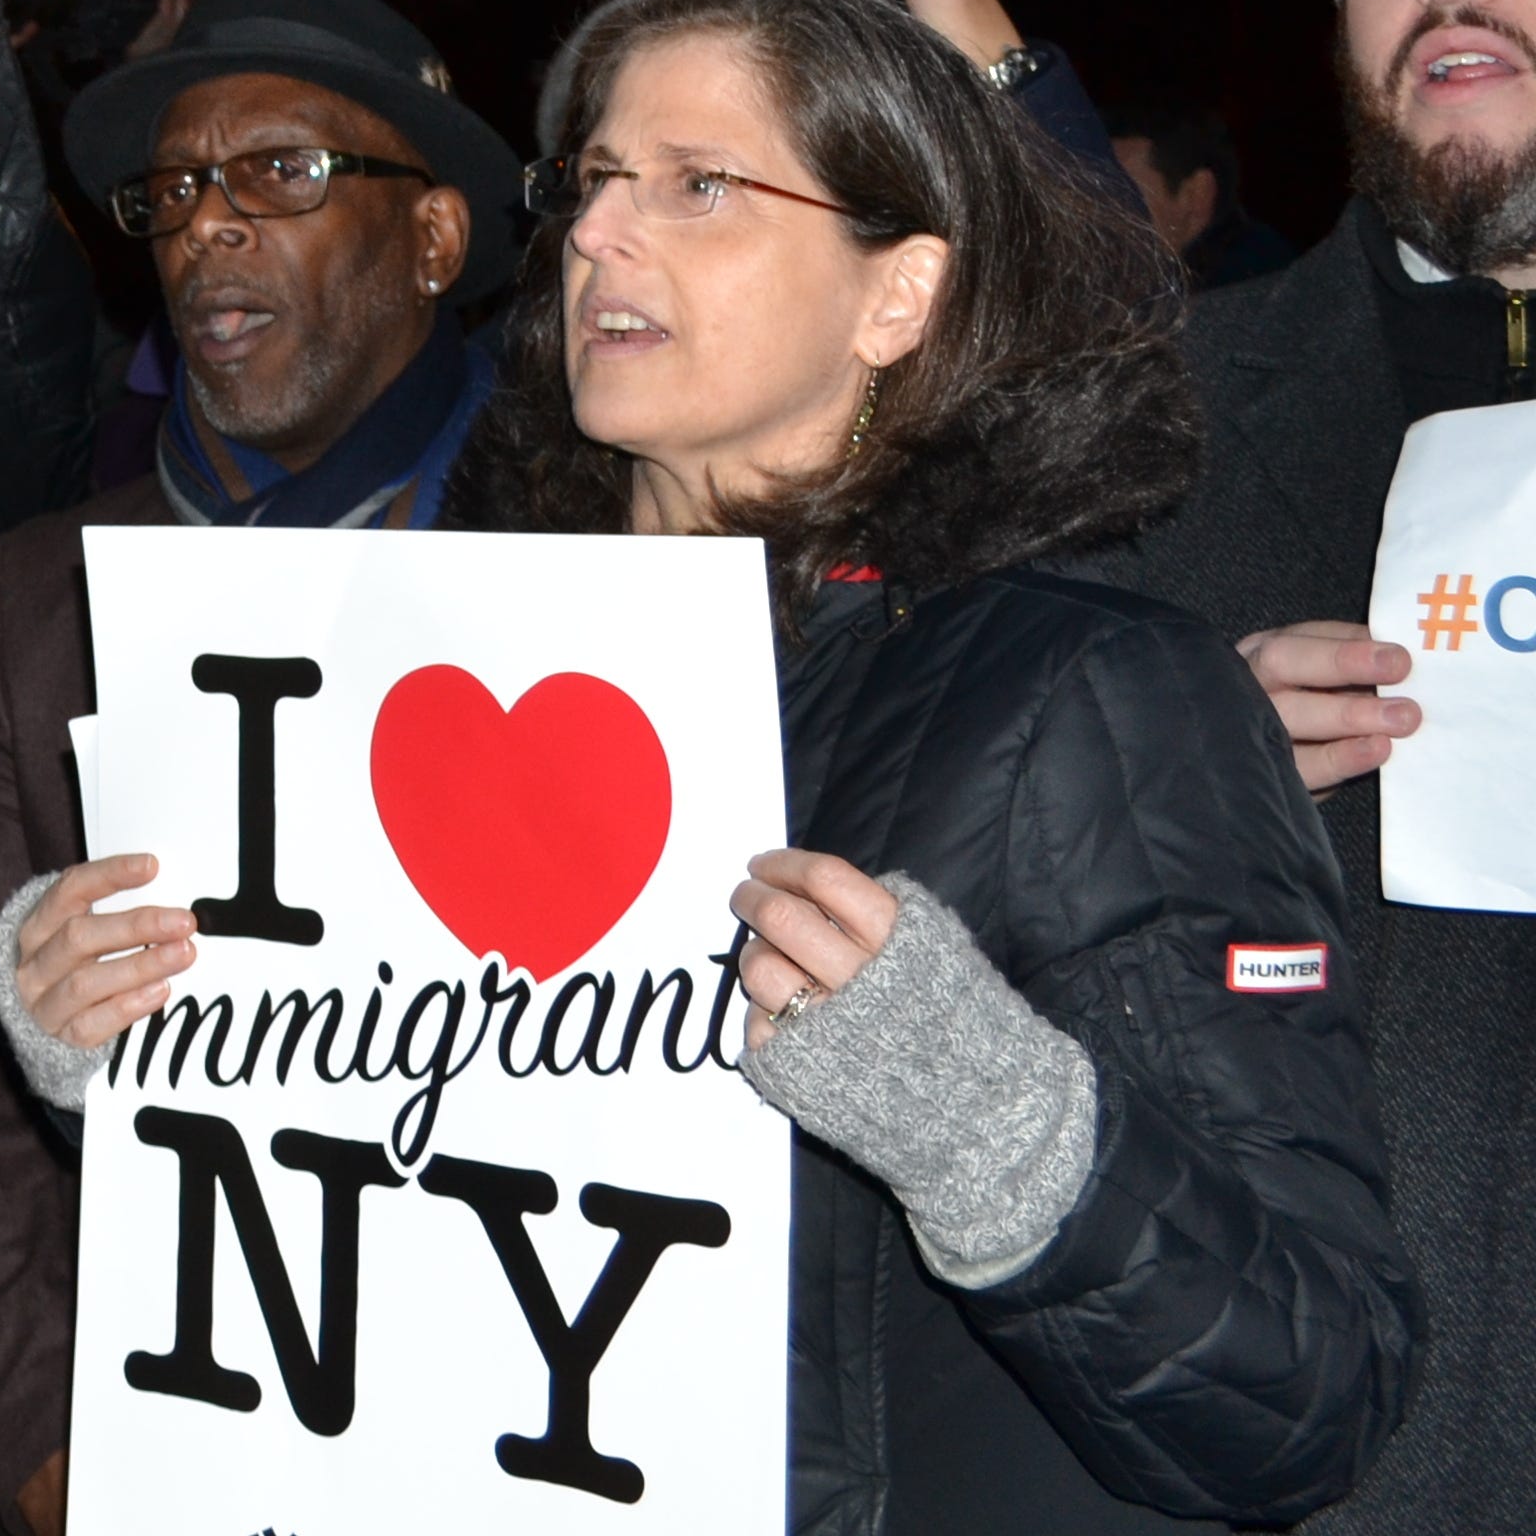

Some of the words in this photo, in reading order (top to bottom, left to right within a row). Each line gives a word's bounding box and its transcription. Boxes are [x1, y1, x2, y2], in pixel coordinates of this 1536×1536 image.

[191, 653, 325, 947] I
[1239, 962, 1321, 978] HUNTER
[124, 1105, 732, 1506] NY
